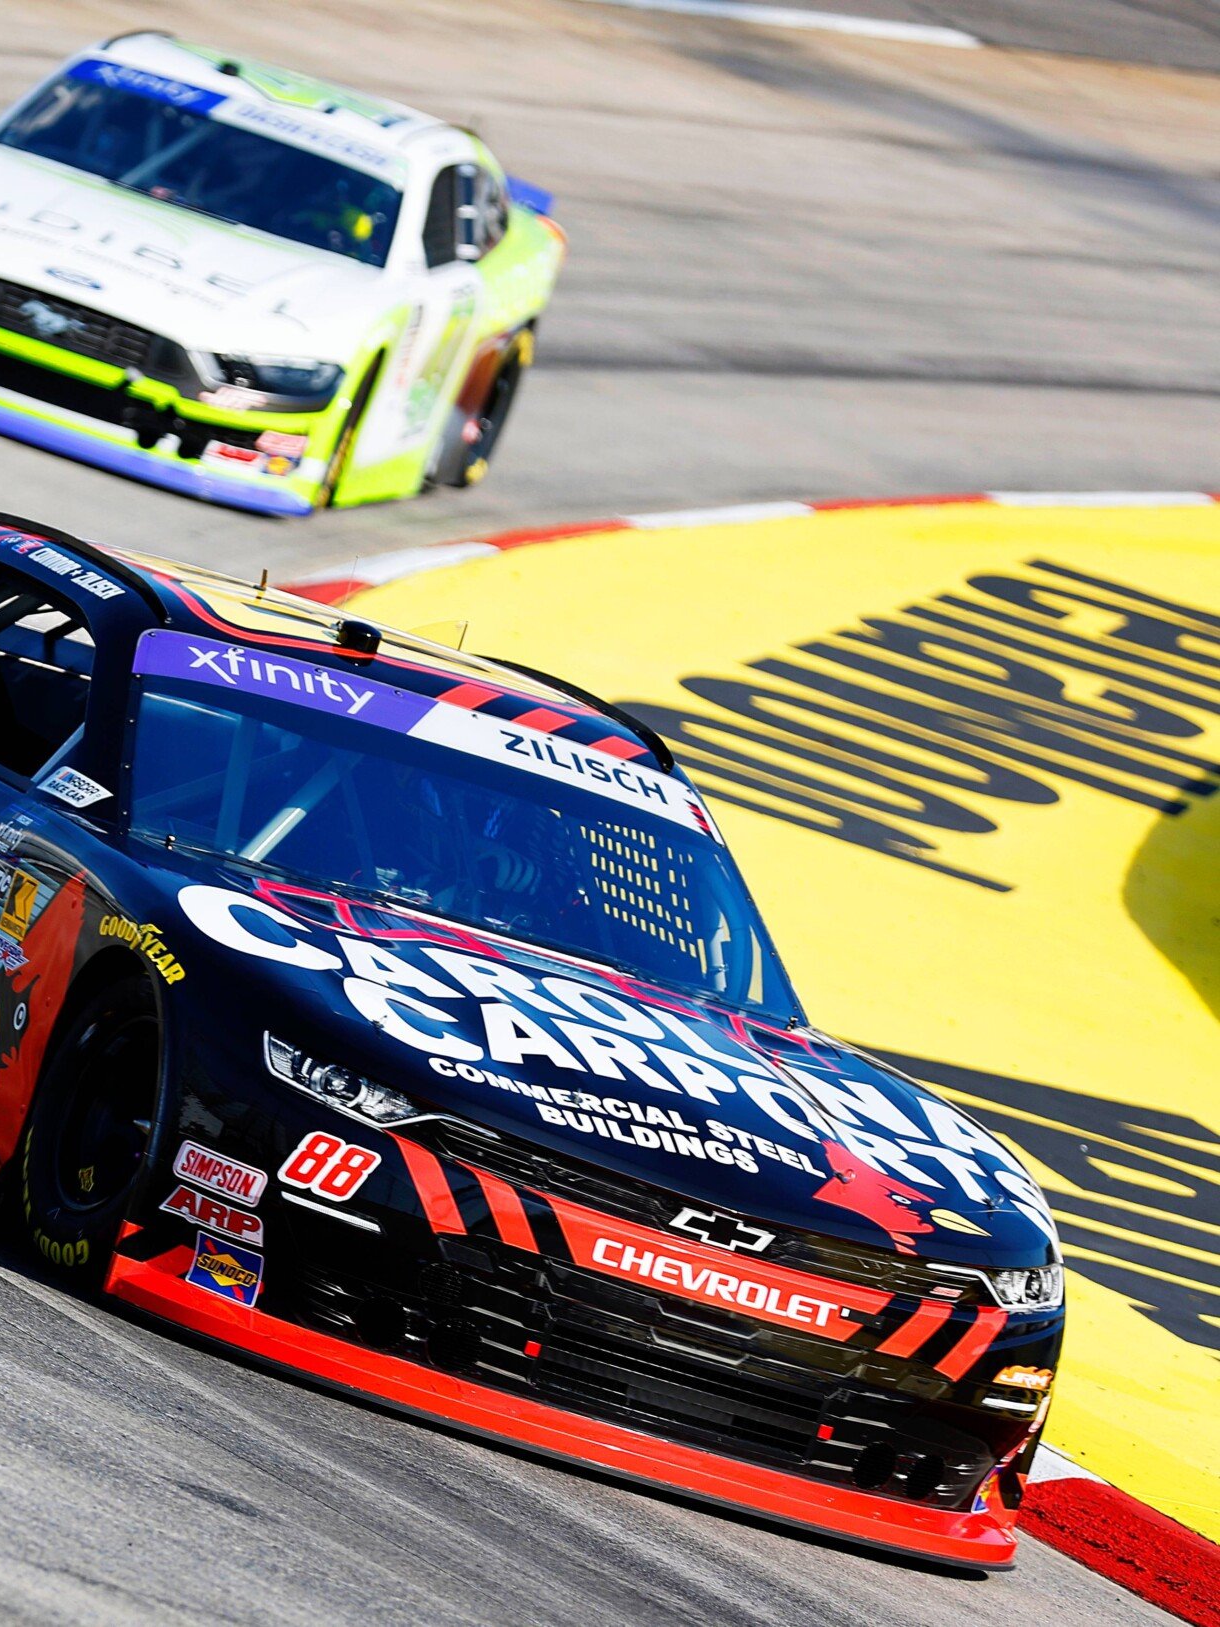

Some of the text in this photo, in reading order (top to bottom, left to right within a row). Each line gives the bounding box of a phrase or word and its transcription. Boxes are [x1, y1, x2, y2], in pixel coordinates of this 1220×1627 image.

[188, 645, 668, 805] xfinity ZILISCH
[99, 914, 186, 985] GOODYEAR
[343, 977, 1058, 1252] CARPORTS
[429, 1057, 827, 1179] COMMERCIAL STEEL
[535, 1102, 759, 1174] BUILDINGS
[180, 1148, 258, 1196] SIMPSON
[278, 1131, 381, 1201] 88
[166, 1186, 262, 1238] ARP
[198, 1253, 258, 1287] SUNOCO
[591, 1237, 838, 1328] CHEVROLET
[999, 1372, 1048, 1388] JRM
